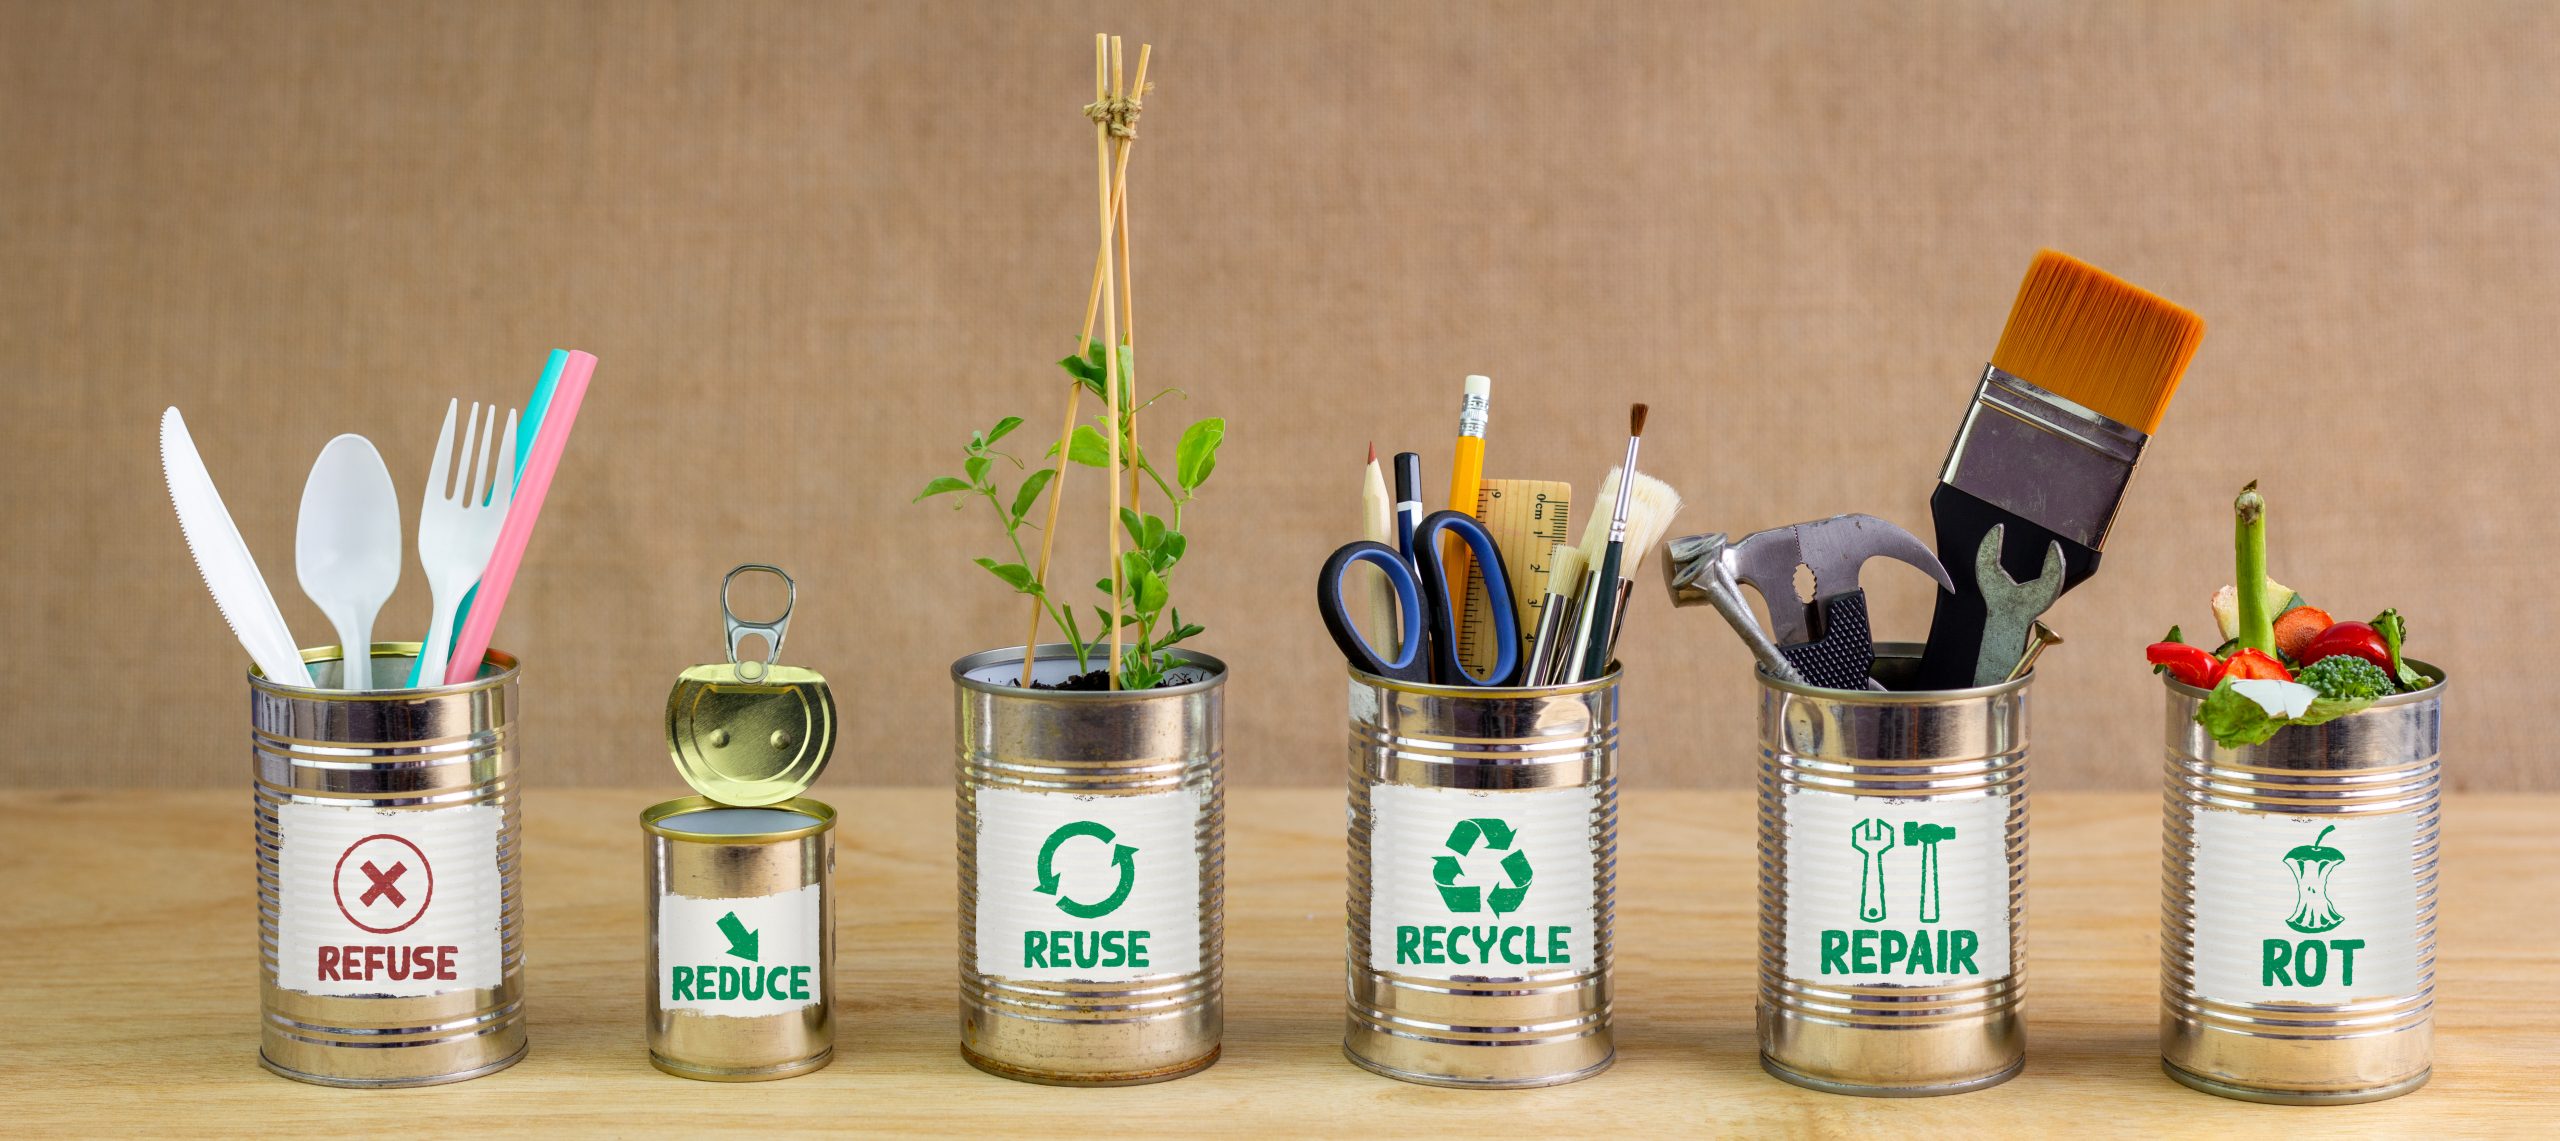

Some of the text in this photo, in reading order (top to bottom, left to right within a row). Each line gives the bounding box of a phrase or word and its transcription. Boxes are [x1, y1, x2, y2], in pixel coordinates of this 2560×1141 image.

[1477, 667, 1485, 675] 4
[317, 945, 459, 982] REFUSE
[1023, 929, 1151, 969] REUSE
[1396, 925, 1572, 966] RECYCLE
[1820, 929, 1980, 976] REPAIR
[2262, 938, 2366, 988] ROT
[671, 965, 812, 1001] REDUCE
